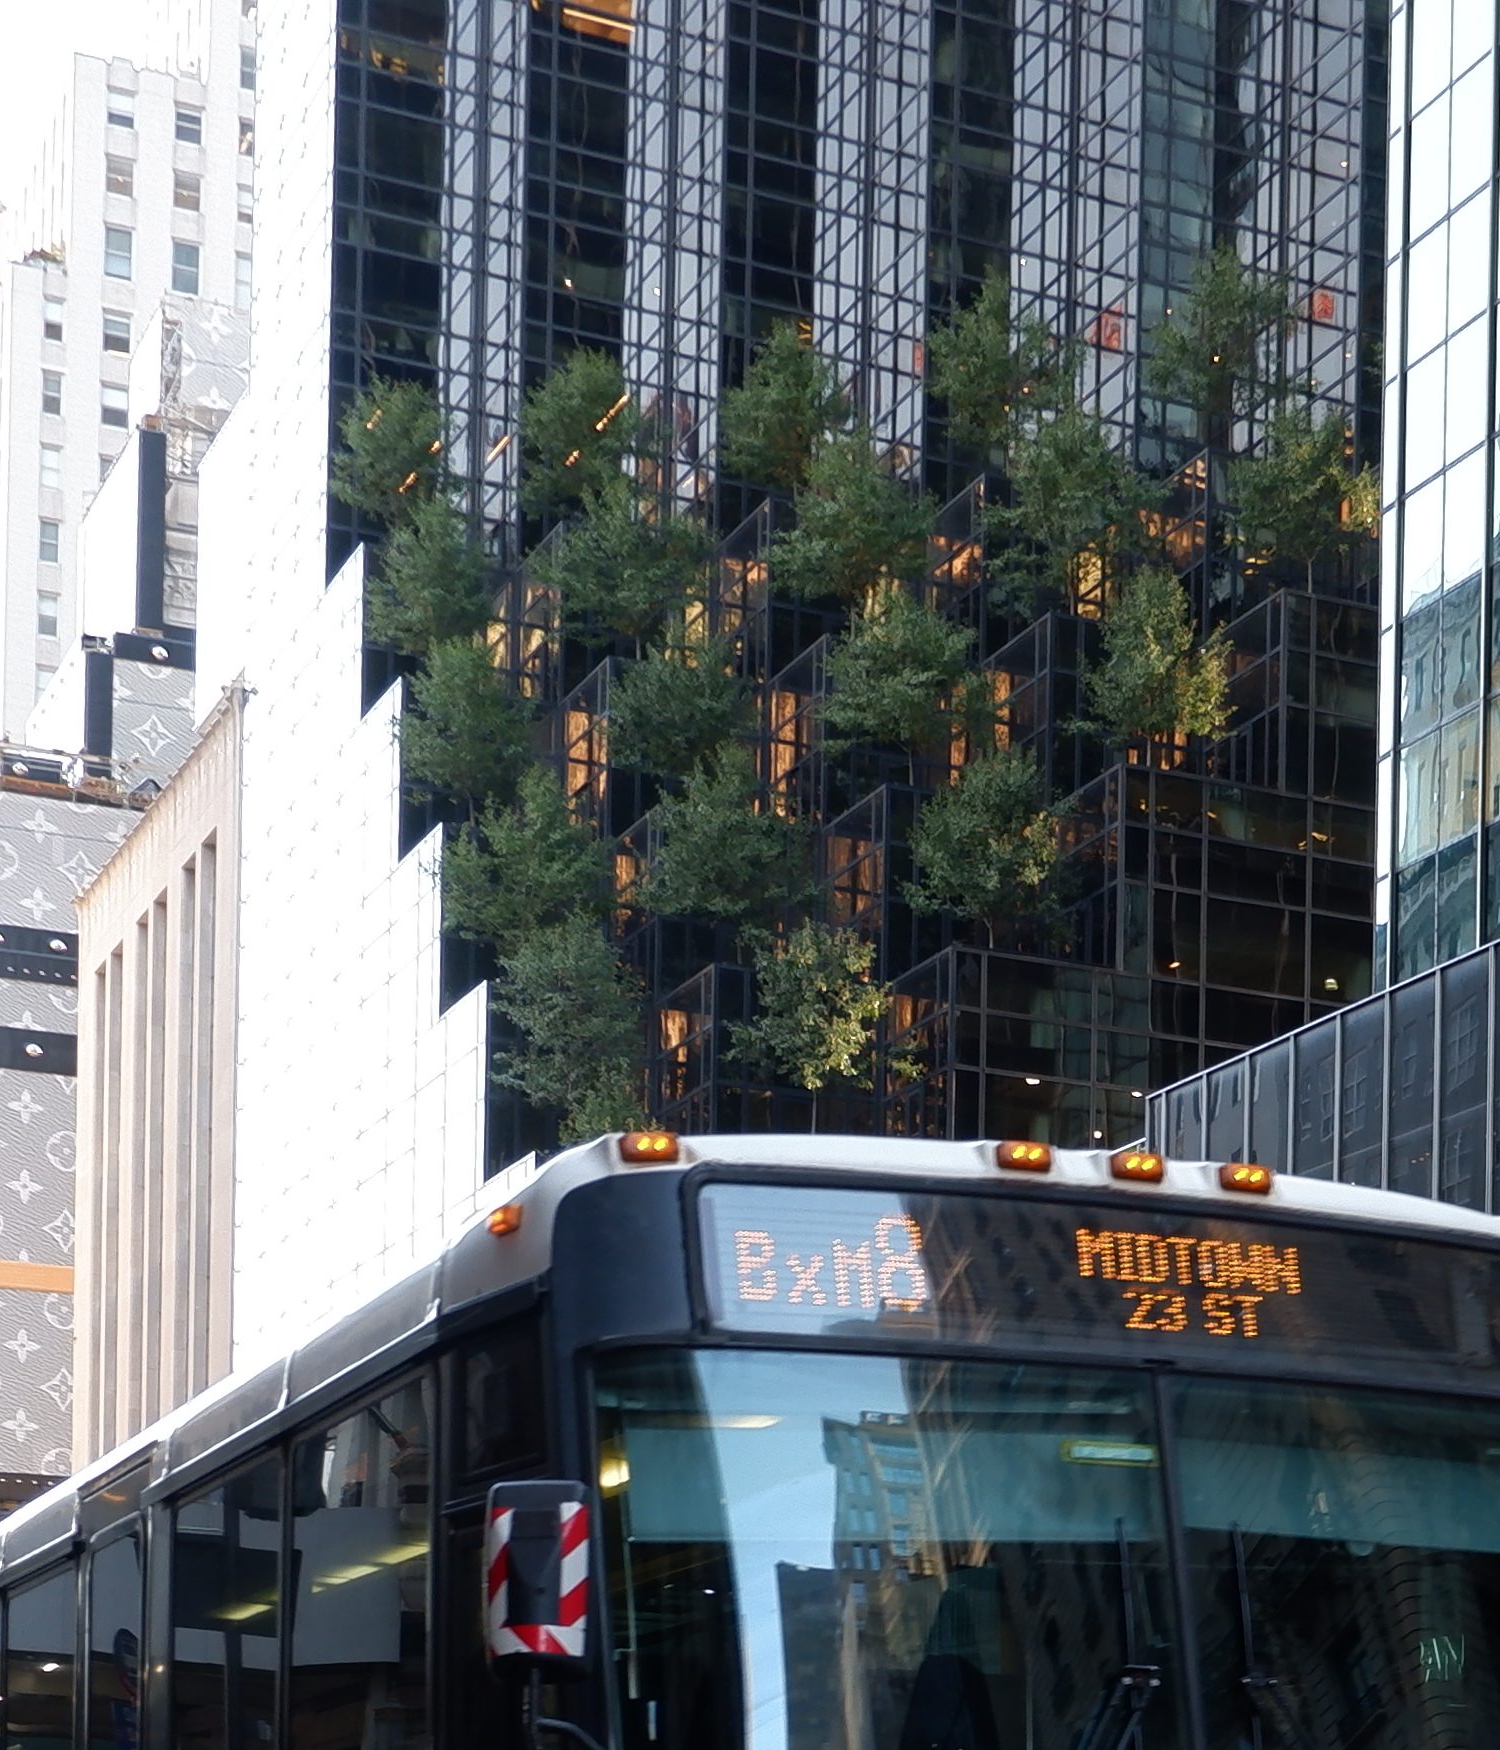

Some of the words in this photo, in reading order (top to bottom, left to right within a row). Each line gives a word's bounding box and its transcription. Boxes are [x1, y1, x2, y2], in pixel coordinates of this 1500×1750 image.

[734, 1213, 927, 1312] BxM8
[1076, 1227, 1301, 1294] MIDTOWN
[1122, 1286, 1188, 1331] 23
[1202, 1292, 1264, 1337] ST
